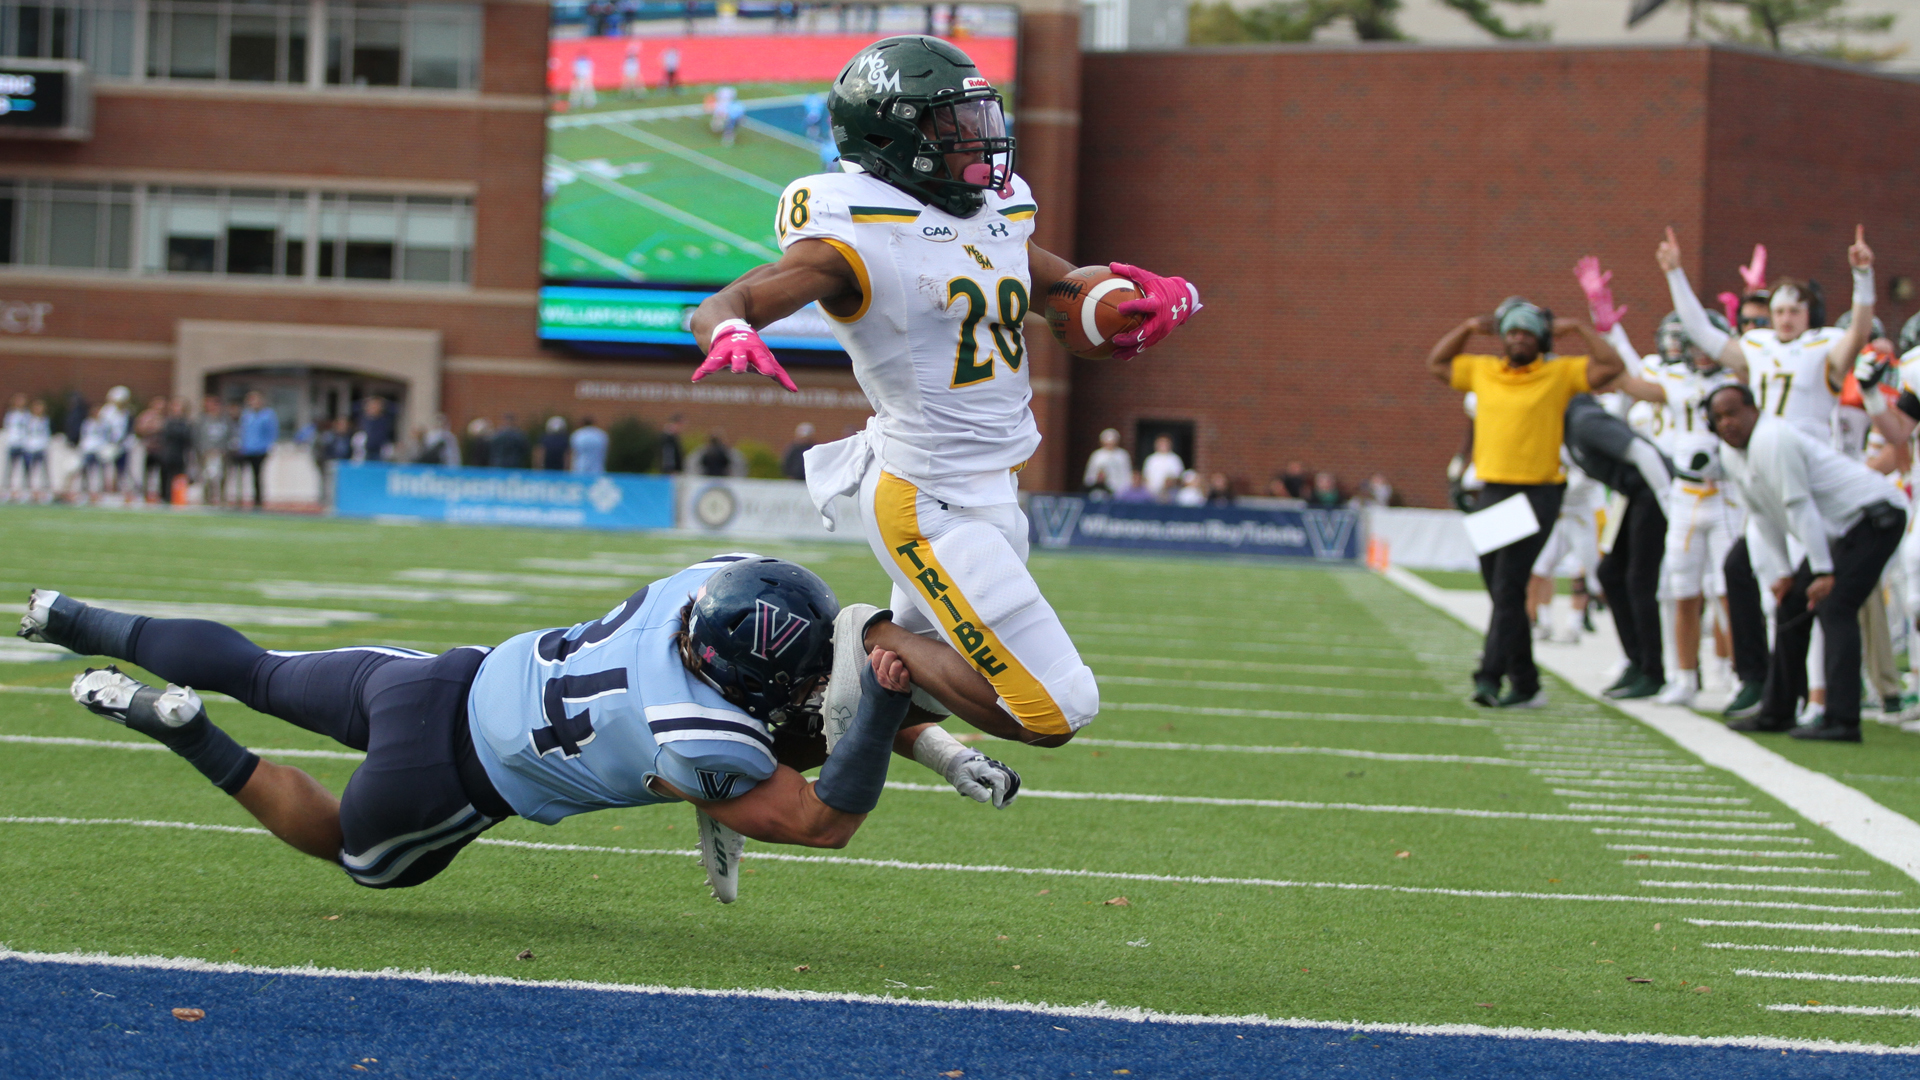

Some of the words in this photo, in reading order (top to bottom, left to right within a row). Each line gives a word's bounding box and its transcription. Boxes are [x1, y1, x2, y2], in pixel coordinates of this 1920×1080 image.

[857, 51, 902, 94] W&M
[922, 226, 953, 236] CAA
[962, 244, 995, 270] W&M
[946, 275, 1031, 389] 28
[1759, 373, 1795, 417] 17
[387, 469, 584, 505] Independence
[751, 598, 810, 661] V
[896, 540, 1008, 677] TRIBE
[694, 767, 747, 799] V
